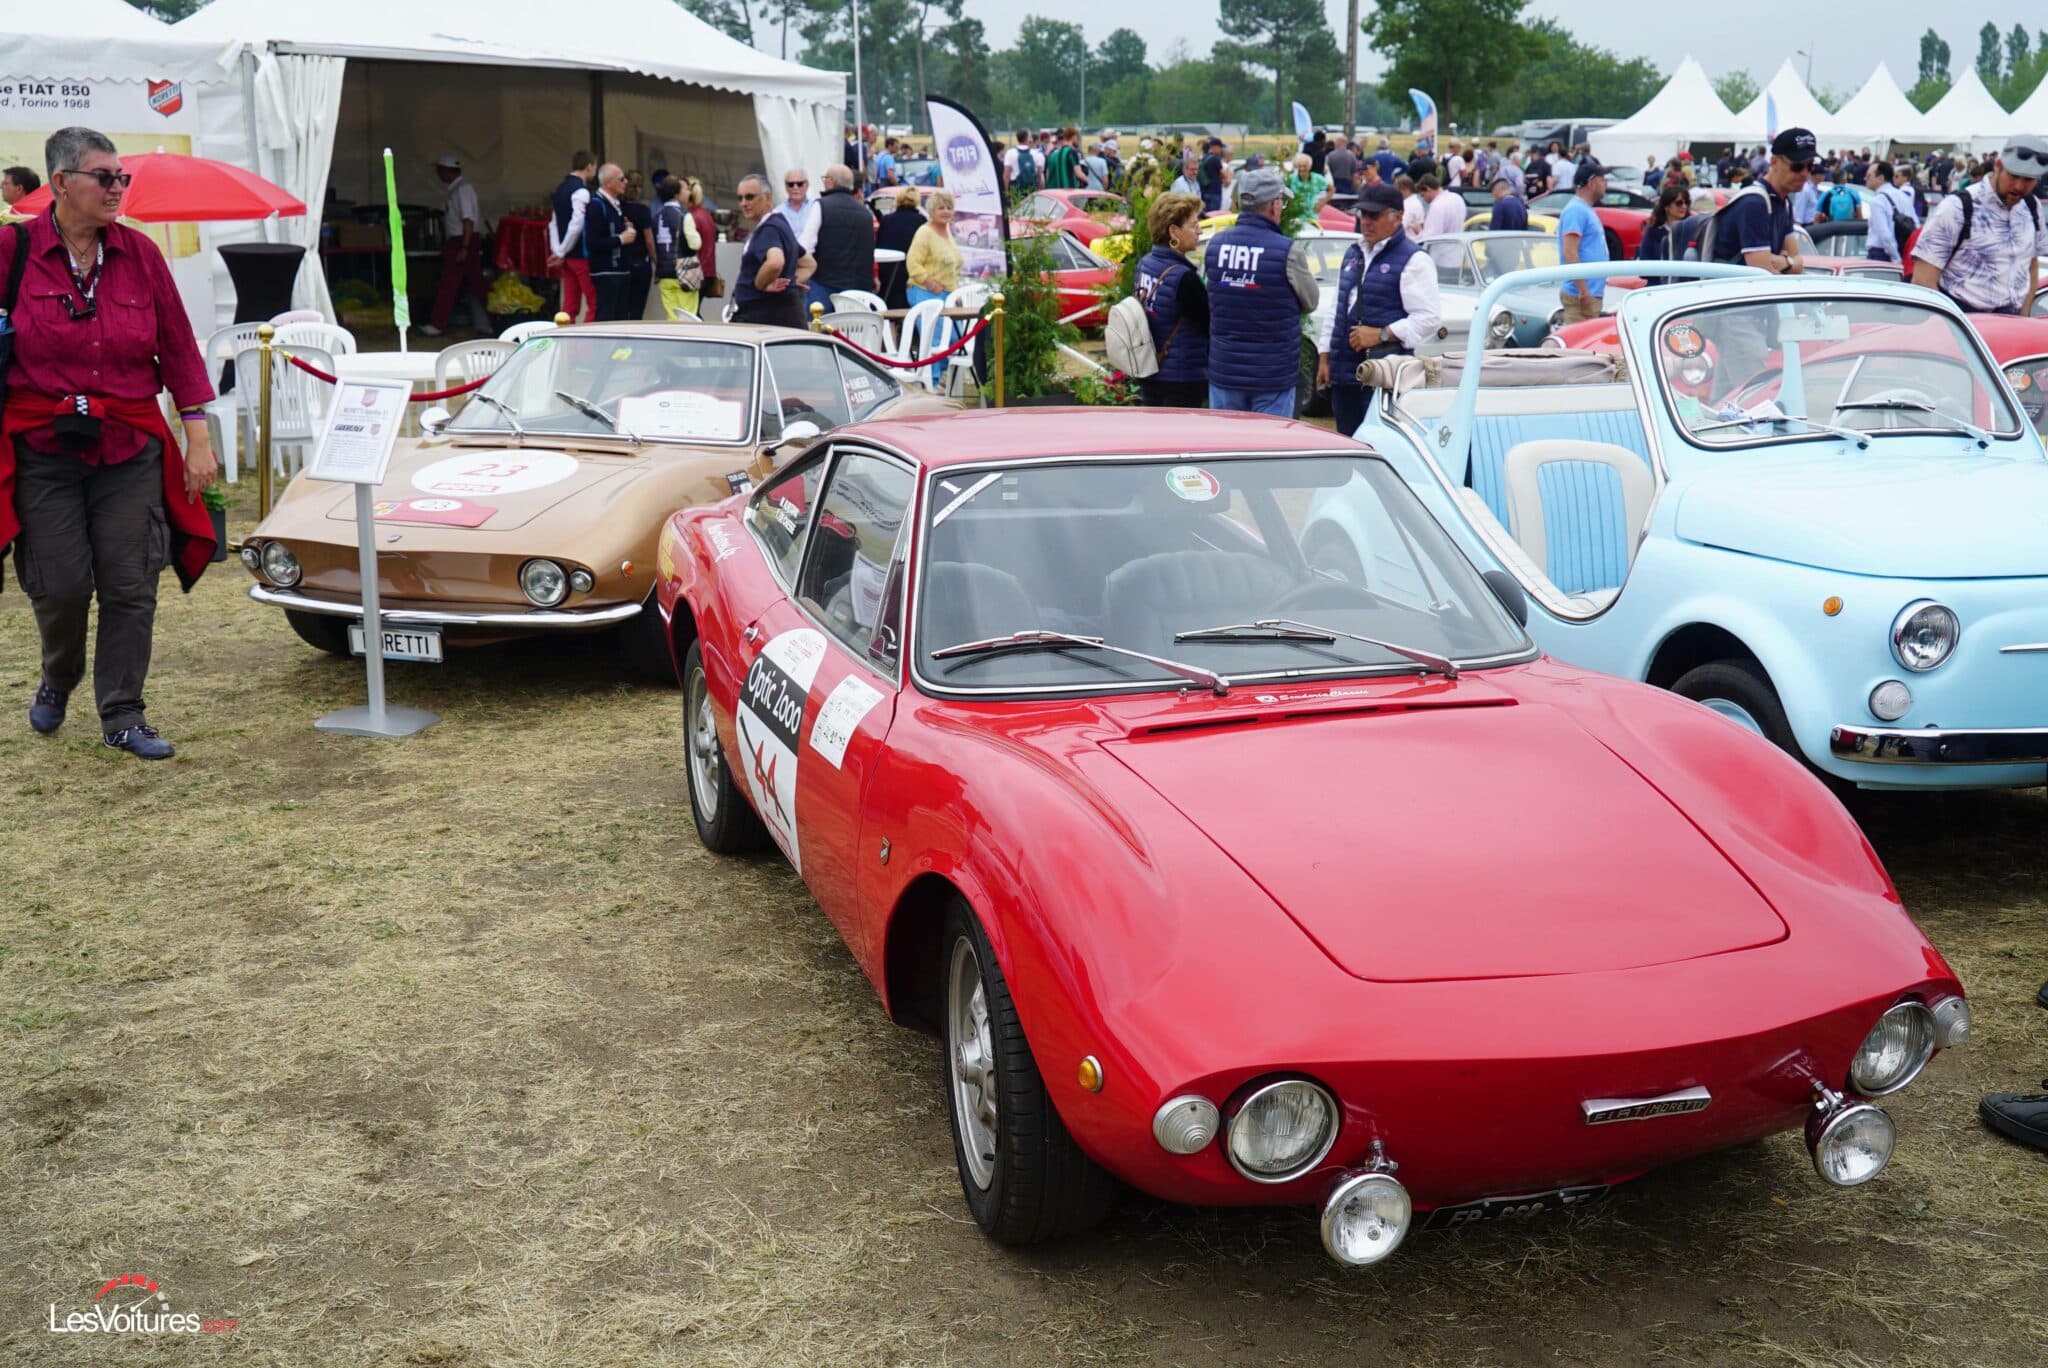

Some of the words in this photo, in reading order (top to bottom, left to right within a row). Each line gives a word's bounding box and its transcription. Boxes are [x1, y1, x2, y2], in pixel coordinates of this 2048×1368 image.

[19, 83, 55, 95] FIAT
[61, 84, 90, 97] 850
[21, 97, 58, 108] Torino
[63, 98, 90, 109] 1968
[1217, 243, 1265, 271] FIAT
[458, 462, 530, 478] 23
[362, 631, 430, 655] RETTI
[748, 657, 777, 710] Optic
[772, 679, 801, 735] 2000
[1595, 1106, 1645, 1121] FIAT
